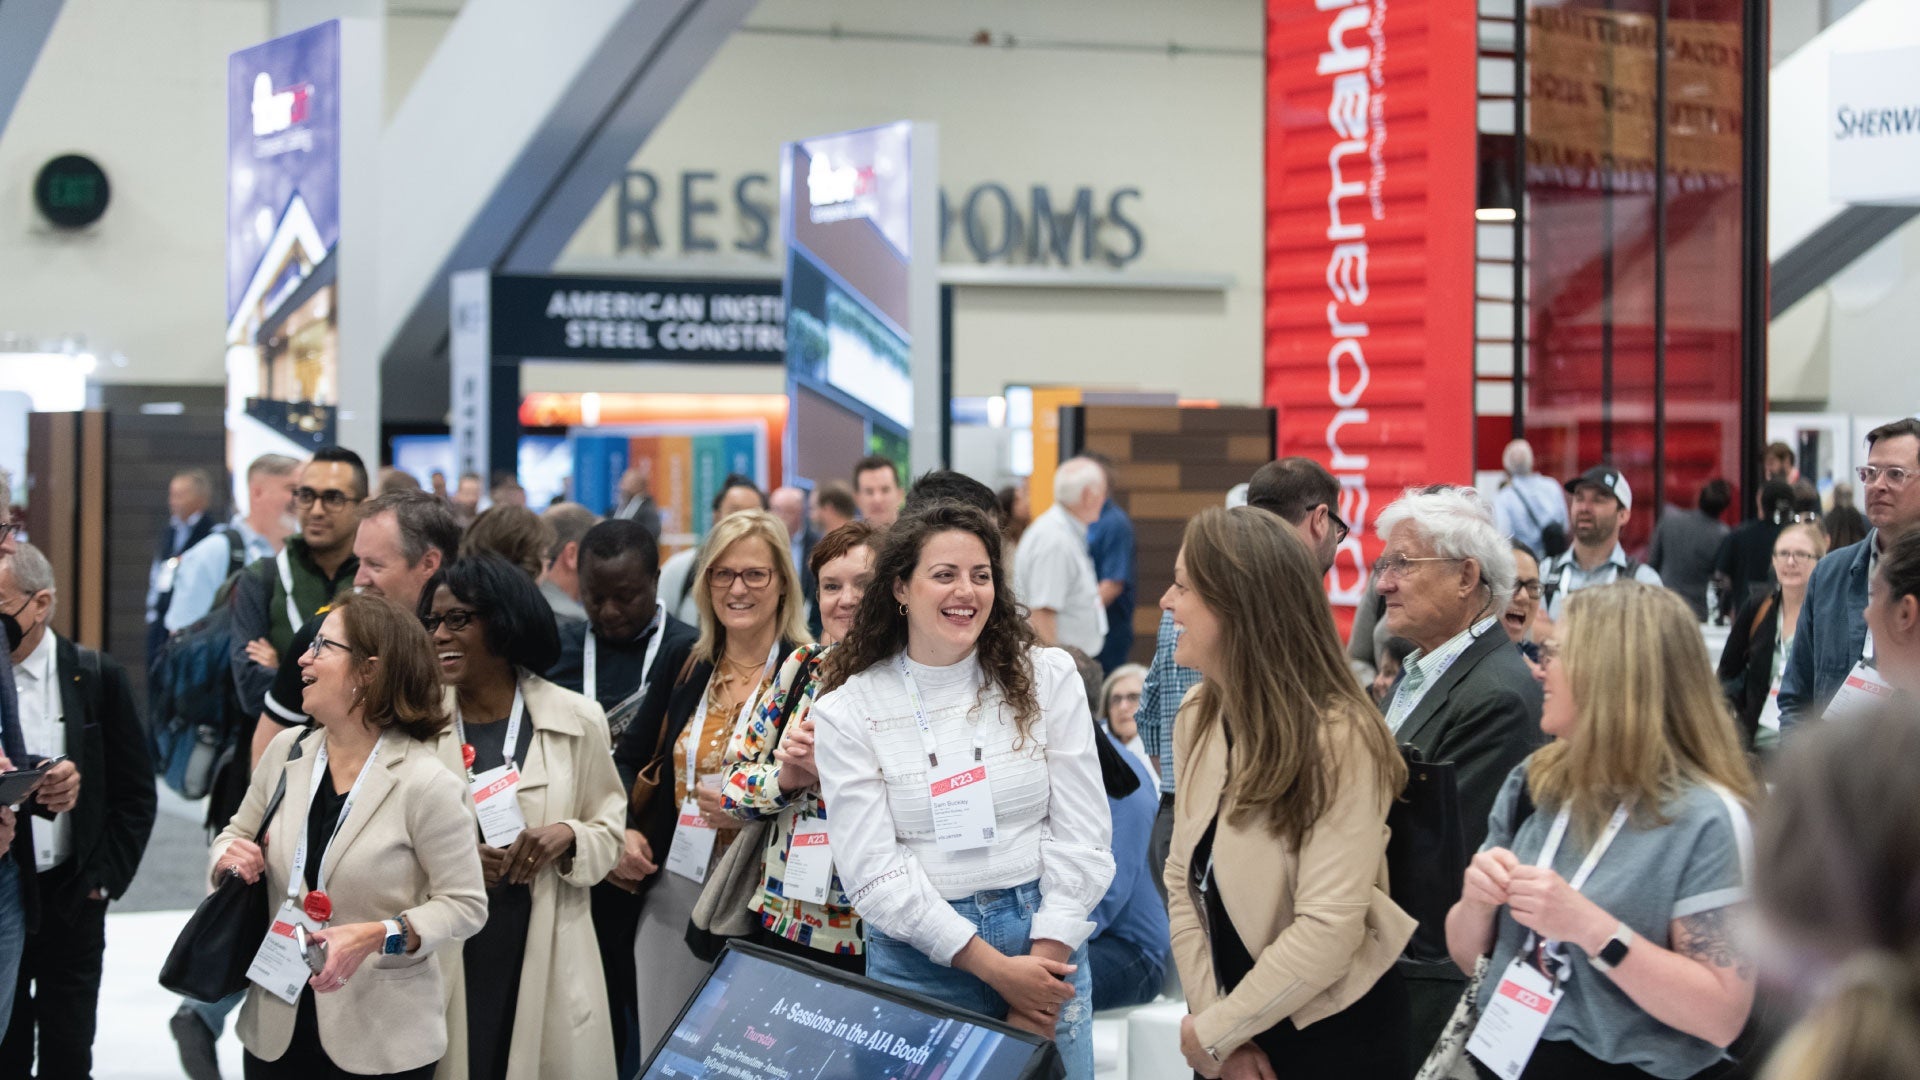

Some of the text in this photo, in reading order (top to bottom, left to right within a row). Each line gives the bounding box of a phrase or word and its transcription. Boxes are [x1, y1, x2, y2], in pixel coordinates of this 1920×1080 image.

[546, 290, 706, 322] AMERICAN
[565, 318, 655, 349] STEEL
[743, 1025, 777, 1050] Thursday
[769, 997, 930, 1065] A+ Sessions in the AIA Booth
